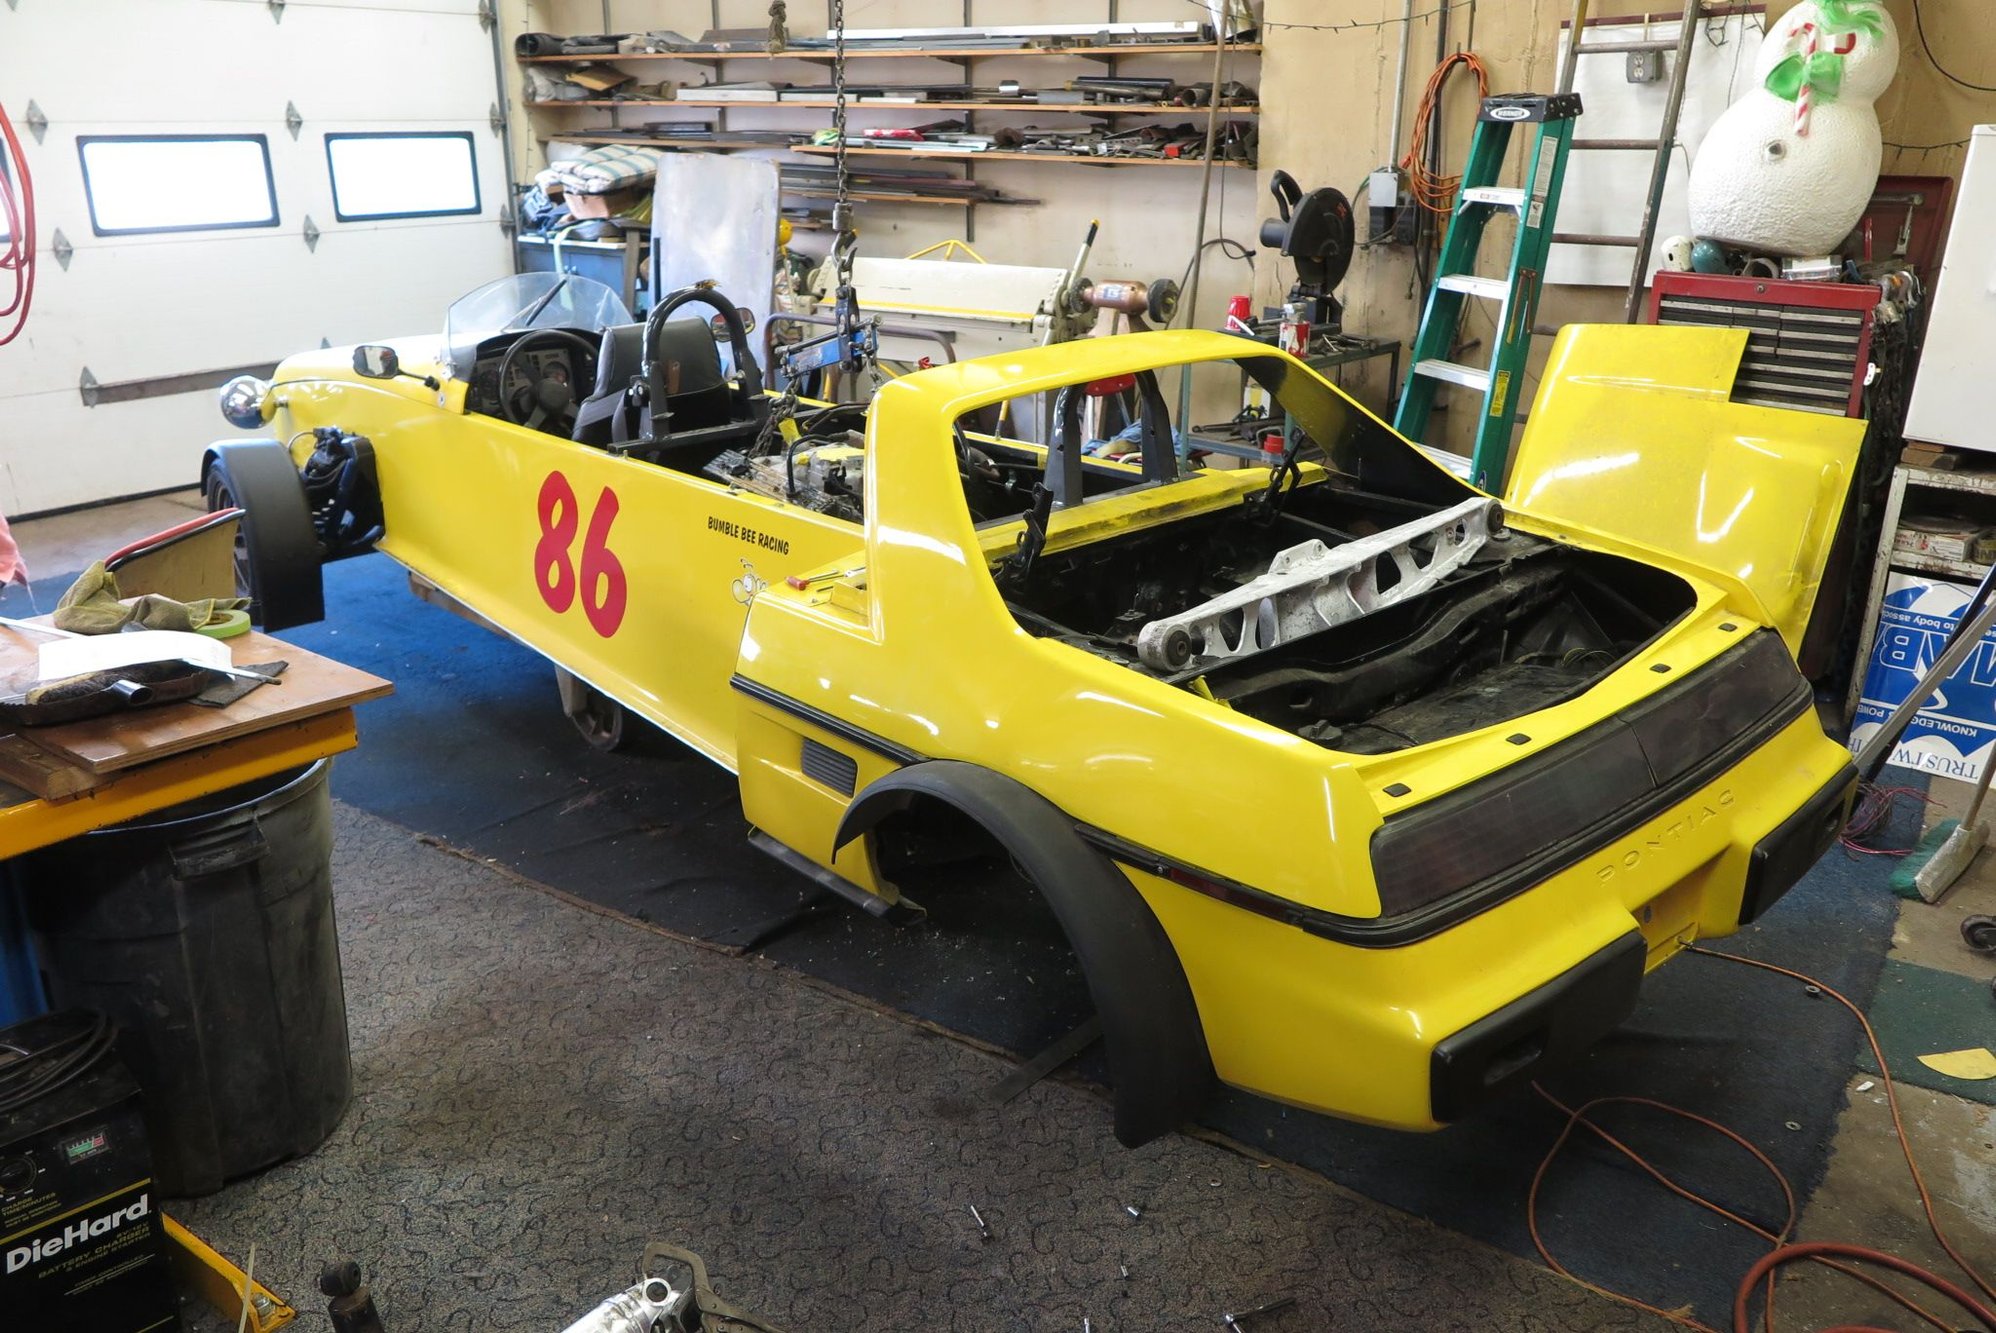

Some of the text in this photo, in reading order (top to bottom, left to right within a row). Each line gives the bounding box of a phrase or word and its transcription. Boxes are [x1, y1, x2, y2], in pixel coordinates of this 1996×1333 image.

[534, 470, 627, 639] 86
[707, 515, 790, 555] BUMBLE BEE RACING
[1912, 615, 1941, 631] body
[1910, 715, 1978, 738] KNOWLEDG
[1596, 789, 1736, 888] PONTIAC
[6, 1193, 150, 1275] DieHard
[38, 1251, 92, 1280] BATTERY
[94, 1226, 150, 1255] CHARGER
